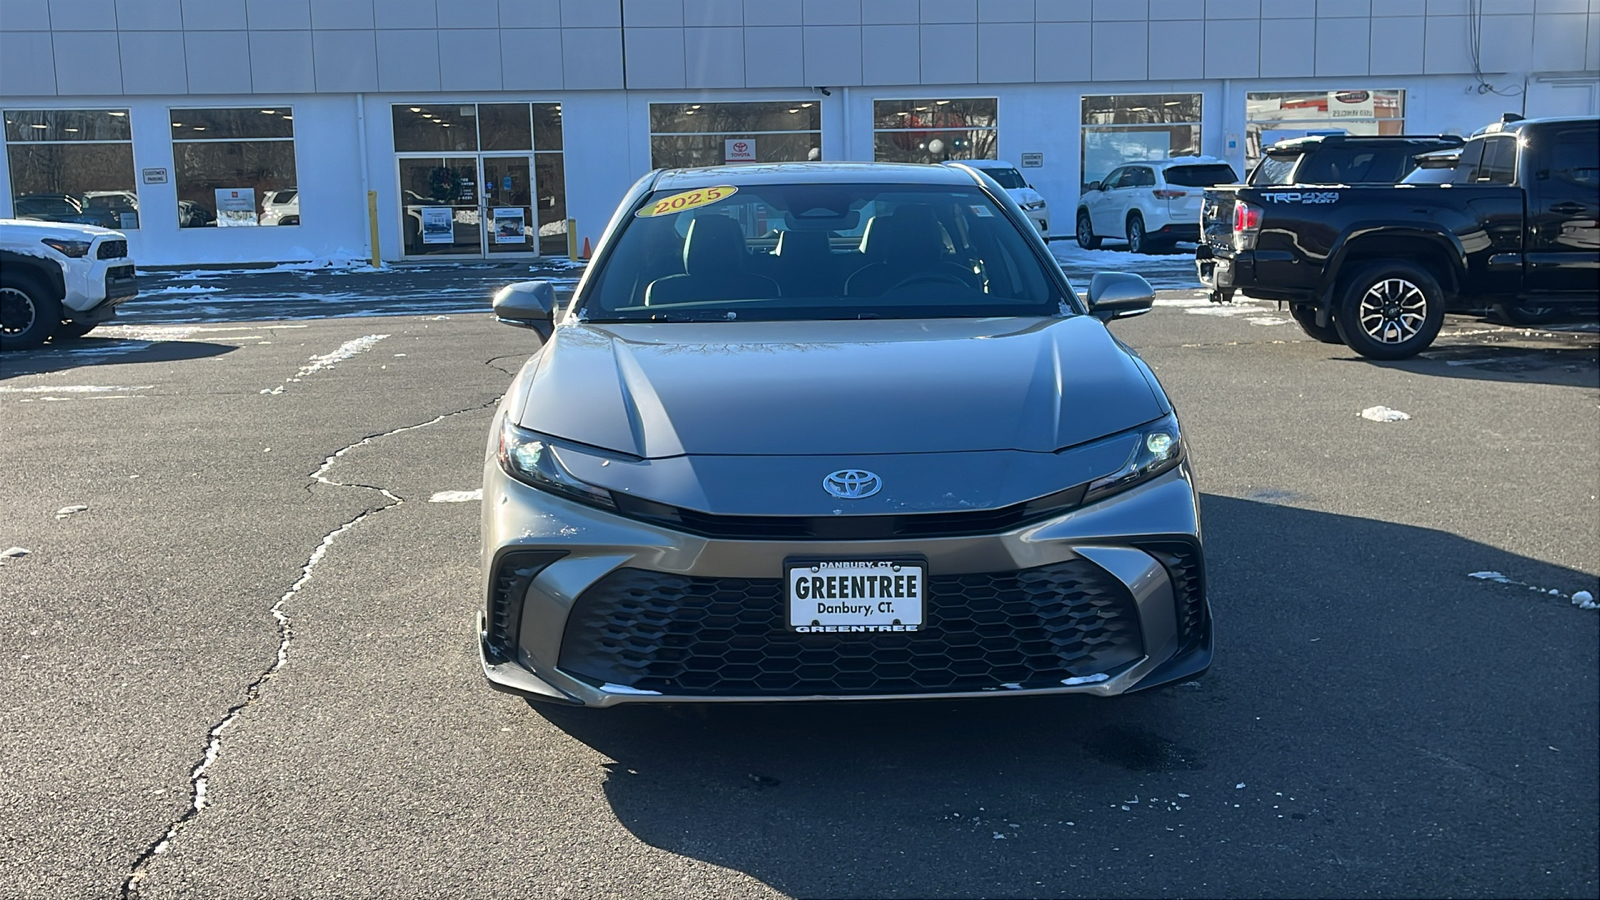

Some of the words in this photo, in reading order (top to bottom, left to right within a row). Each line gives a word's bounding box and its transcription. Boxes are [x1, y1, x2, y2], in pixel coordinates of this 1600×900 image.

[655, 188, 721, 214] 2025
[1261, 192, 1301, 204] TRD
[795, 575, 917, 600] GREENTREE
[817, 602, 874, 617] Danbury,
[878, 602, 895, 613] CT.
[795, 625, 918, 633] GREENTREE
